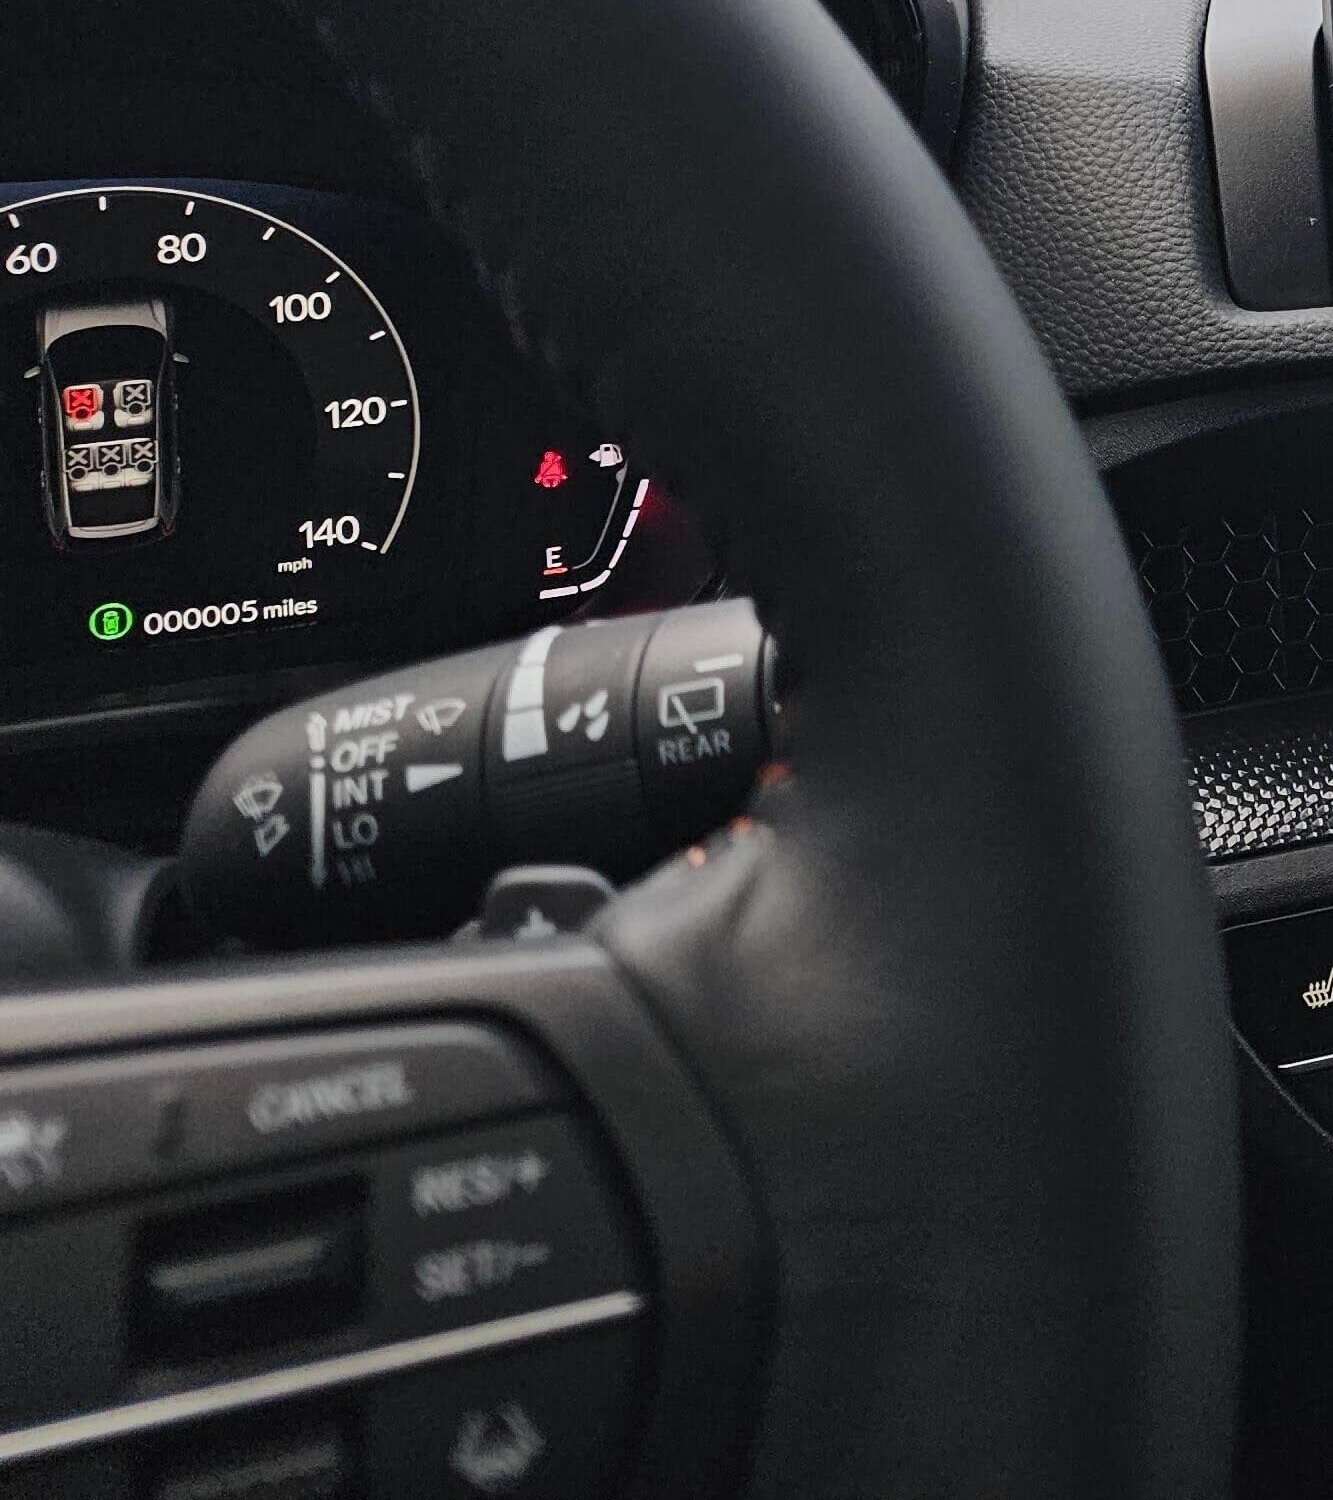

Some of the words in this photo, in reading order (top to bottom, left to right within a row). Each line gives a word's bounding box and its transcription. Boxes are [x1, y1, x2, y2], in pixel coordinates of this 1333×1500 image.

[4, 241, 58, 275] 60
[156, 232, 207, 265] 80
[268, 291, 332, 325] 100
[323, 396, 387, 431] 120
[297, 515, 361, 548] 140
[277, 557, 313, 575] mph
[545, 546, 565, 567] E
[142, 599, 259, 635] 000005
[262, 596, 319, 621] miles
[334, 694, 415, 731] MIST
[331, 734, 400, 772] OFF
[657, 729, 733, 765] REAR
[332, 769, 389, 807] INT
[332, 813, 379, 850] LO
